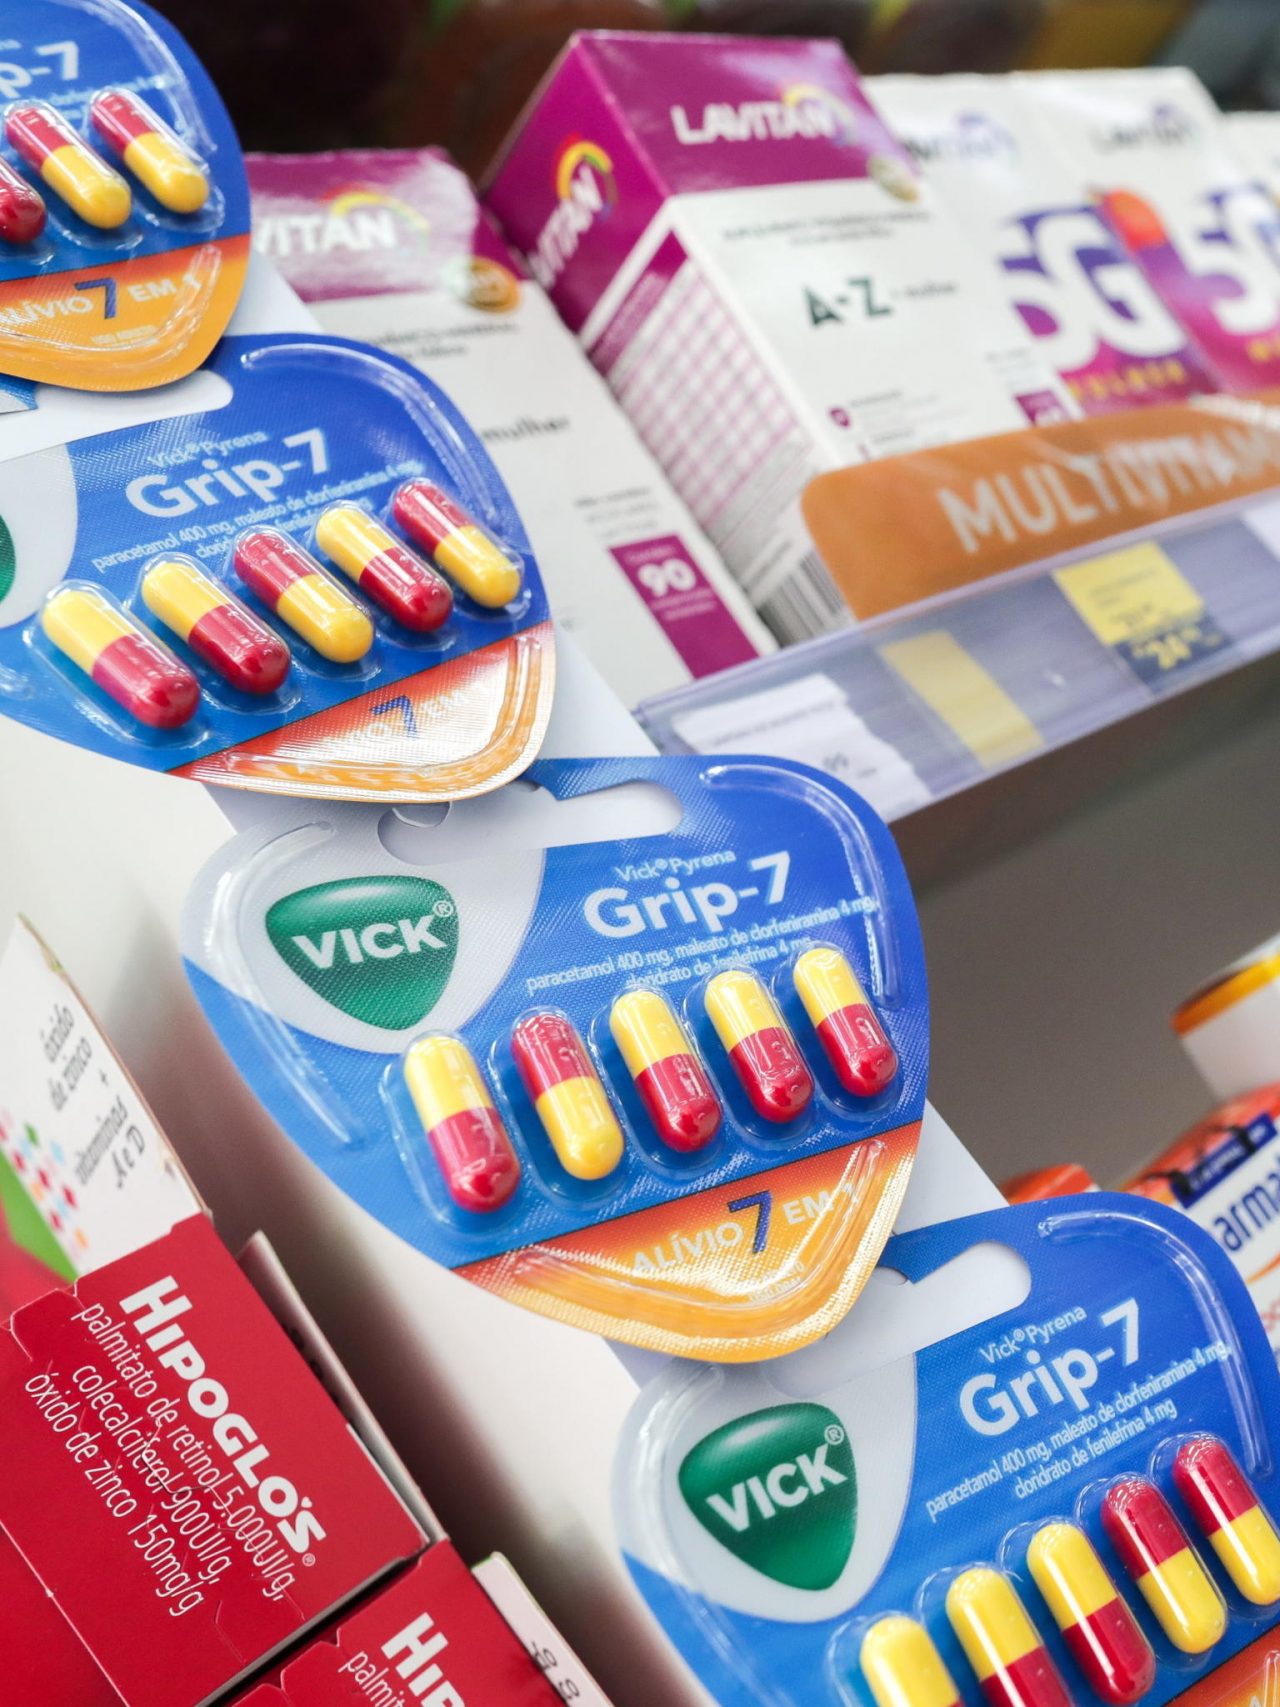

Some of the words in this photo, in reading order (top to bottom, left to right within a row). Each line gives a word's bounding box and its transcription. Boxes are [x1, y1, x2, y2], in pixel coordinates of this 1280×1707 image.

[670, 101, 836, 145] LAVITAN
[74, 277, 117, 319] 7
[128, 279, 176, 302] EM
[803, 276, 893, 327] A-Z
[125, 428, 329, 518] Grip-7
[203, 431, 268, 457] Pyrena
[91, 536, 181, 574] paracetamol
[179, 525, 206, 543] 400
[234, 502, 288, 526] maleato
[637, 558, 696, 598] 90
[369, 695, 420, 740] 7
[583, 850, 791, 938] Grip-7
[671, 850, 737, 876] Pyrena
[526, 957, 614, 994] paracetamol
[617, 950, 645, 970] 400
[645, 946, 675, 968] mg,
[675, 935, 730, 959] maleato
[751, 905, 841, 941] clorfeniramina
[61, 1036, 93, 1094] zinco
[74, 1094, 129, 1187] vitaminas
[630, 1220, 744, 1275] ALÍVIO
[727, 1190, 773, 1254] 7
[782, 1190, 835, 1226] EM
[959, 1297, 1140, 1437] Grip-7
[1026, 1305, 1088, 1348] Pyrena
[71, 1302, 158, 1399] palmitato
[146, 1397, 181, 1428] de
[167, 1423, 234, 1494] retinol
[72, 1364, 184, 1494] colecalciferol
[925, 1462, 1003, 1524] paracetamol
[1001, 1449, 1026, 1473] 400
[1024, 1438, 1052, 1463] mg,
[1050, 1413, 1099, 1447] maleato
[1114, 1357, 1198, 1414] clorfeniramina
[1013, 1458, 1073, 1500] cloridrato
[1087, 1415, 1147, 1461] fenilefrina
[1154, 1398, 1179, 1424] mg
[24, 1372, 81, 1433] óxido
[65, 1431, 102, 1464] de
[84, 1460, 138, 1518] zinco
[127, 1514, 205, 1618] 150mg/g
